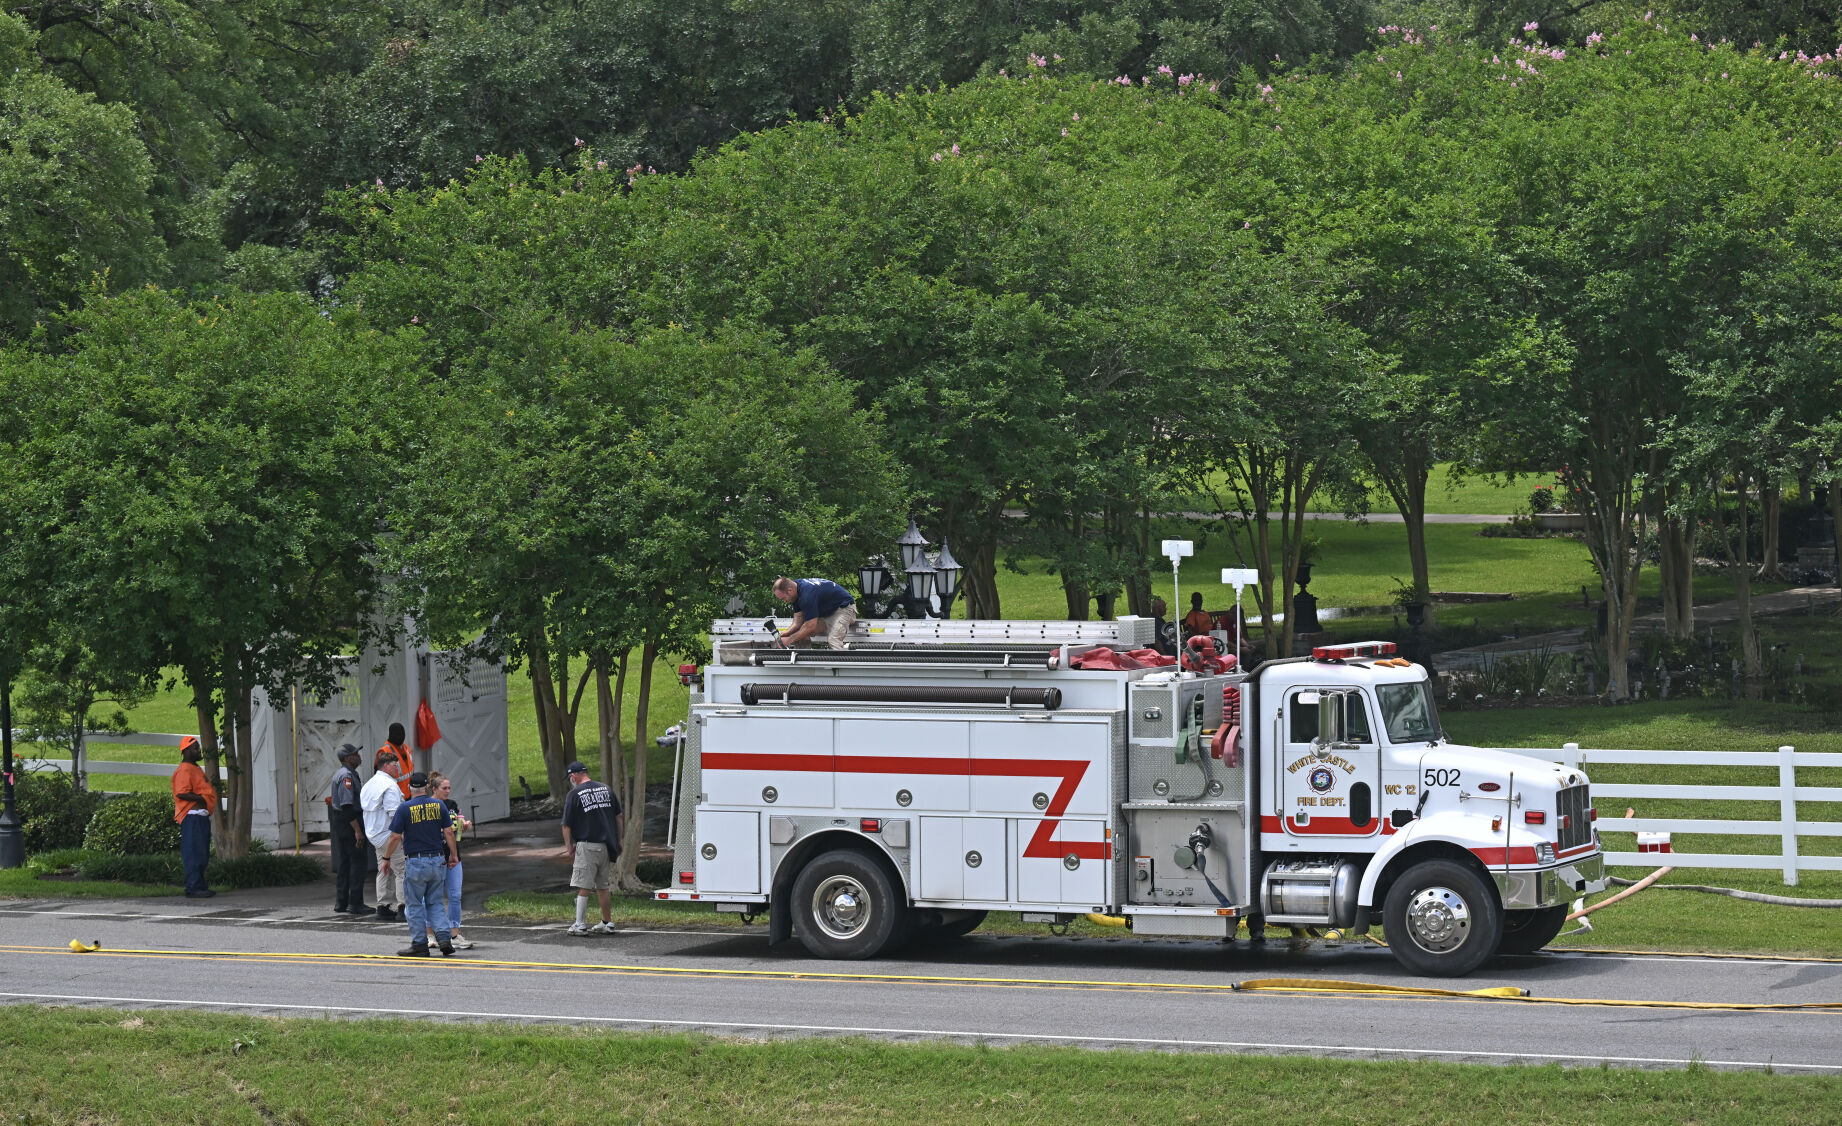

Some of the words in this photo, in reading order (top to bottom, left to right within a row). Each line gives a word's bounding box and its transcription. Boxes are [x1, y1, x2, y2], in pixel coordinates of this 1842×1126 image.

[1287, 755, 1316, 774] WHITE
[1424, 768, 1461, 787] 502
[1384, 784, 1402, 795] WC
[1405, 784, 1417, 795] 12
[1297, 796, 1317, 806] FIRE
[1320, 797, 1346, 807] DEPT.
[411, 810, 422, 824] FIRE
